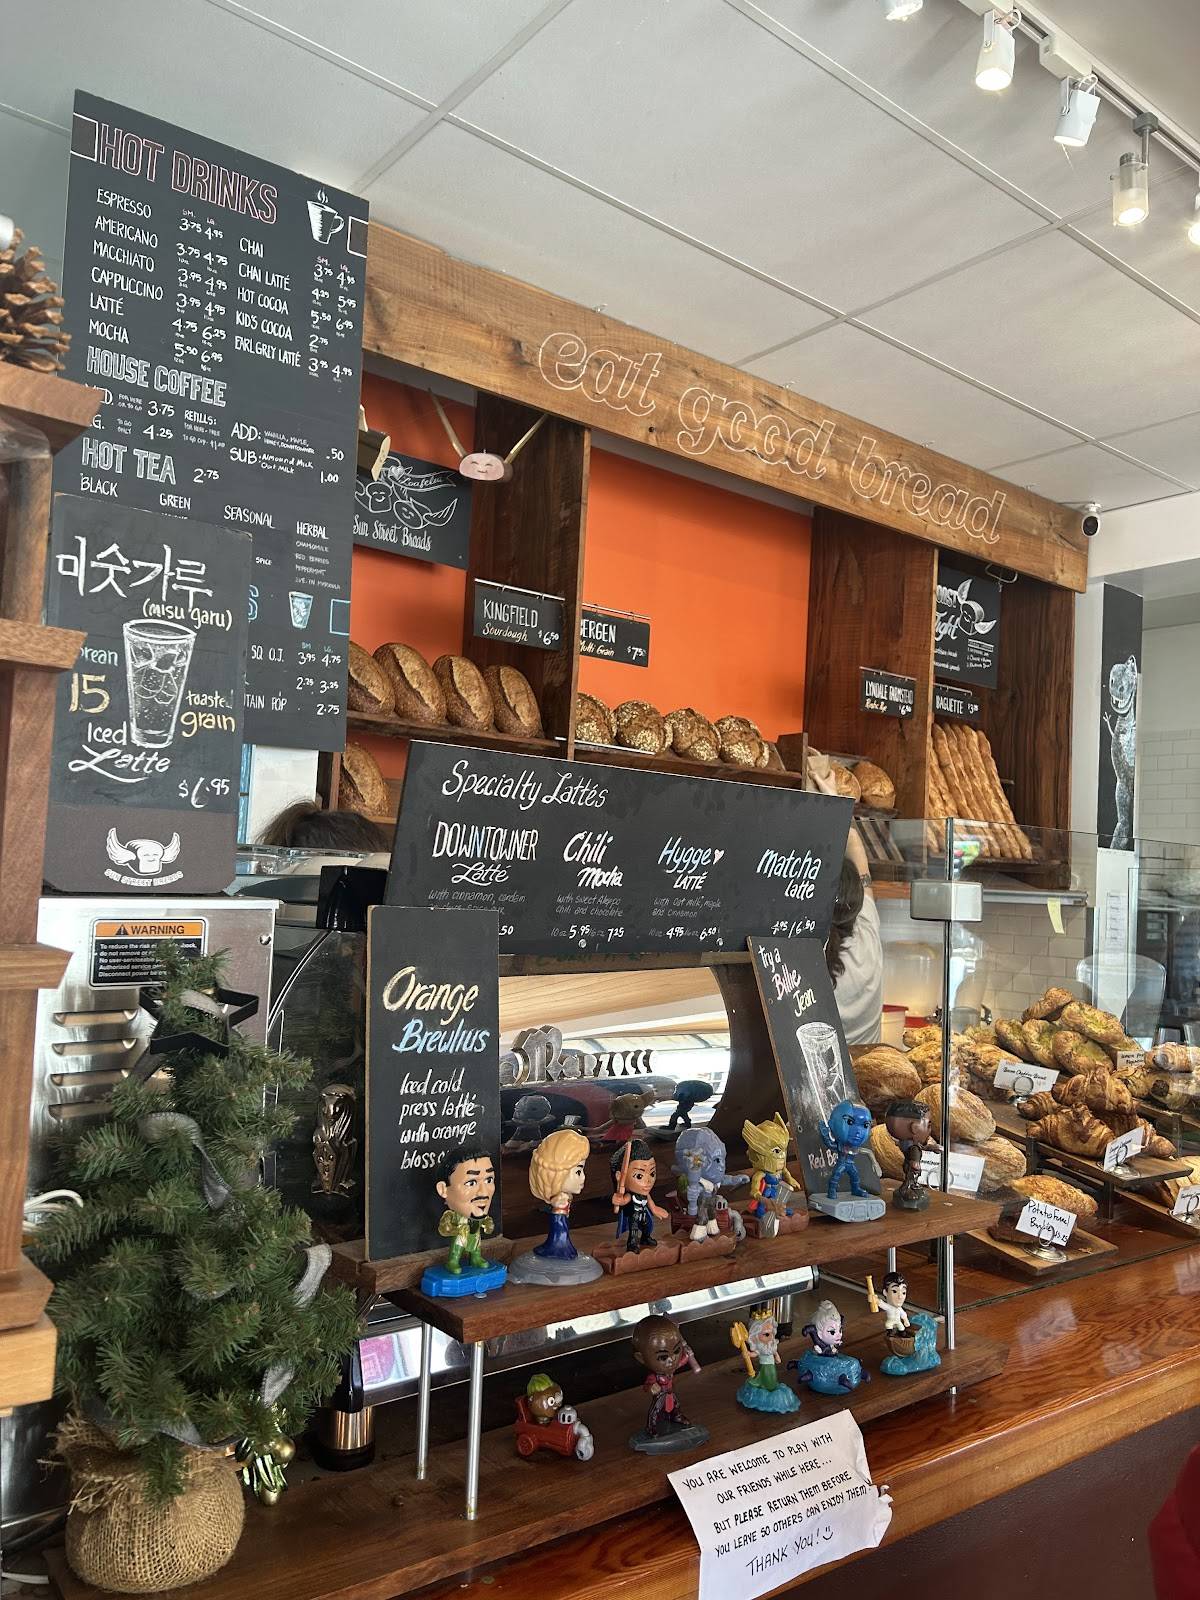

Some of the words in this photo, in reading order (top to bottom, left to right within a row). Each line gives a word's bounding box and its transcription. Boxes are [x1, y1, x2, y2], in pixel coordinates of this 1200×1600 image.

[100, 123, 164, 181] HOT
[172, 150, 277, 224] DRINKS
[97, 189, 152, 218] ESPRESSO
[95, 215, 158, 248] AMERICANO
[179, 218, 202, 233] 3.75
[204, 227, 223, 240] 4.95
[93, 240, 154, 272] MACCHIATO
[176, 243, 200, 258] 3.75
[203, 252, 228, 266] 4.75
[239, 237, 263, 258] CHAI
[91, 266, 163, 300] CAPPUCCINO
[177, 268, 201, 283] 3.95
[205, 277, 227, 291] 4.95
[239, 263, 261, 281] CHAI
[90, 293, 124, 316] LATTÉ
[176, 293, 201, 308] 3.95
[205, 302, 225, 317] 4.95
[237, 287, 255, 304] HOT
[257, 294, 288, 315] COCOA
[89, 319, 129, 344] MOCHA
[202, 326, 226, 340] 6.25
[236, 310, 258, 329] KID'S
[261, 319, 292, 341] COCOA
[201, 350, 223, 363] 6.95
[235, 336, 255, 354] EARL
[255, 341, 276, 360] GREY
[86, 346, 150, 388] HOUSE
[154, 365, 227, 408] COFFEE
[148, 401, 175, 417] 3.75
[142, 424, 173, 440] 4.25
[231, 422, 262, 442] ADD:
[540, 332, 662, 417] eat
[677, 387, 836, 480] good
[849, 438, 1006, 544] bread
[81, 437, 127, 474] HOT
[133, 449, 176, 485] TEA
[326, 448, 344, 461] .50
[80, 476, 119, 498] BLACK
[193, 468, 219, 483] 2.75
[320, 472, 339, 484] 1.00
[159, 493, 190, 510] GREEN
[224, 505, 276, 529] SEASONAL
[296, 521, 329, 540] HERBAL
[372, 519, 401, 544] Street
[401, 526, 432, 552] Breads
[55, 535, 213, 611] 미숫가루
[142, 598, 185, 620] (misu
[191, 607, 233, 631] garu)
[483, 599, 538, 629] KINGFIELD
[482, 623, 528, 642] Sourdough
[69, 673, 110, 713] 15
[936, 695, 964, 714] BAGUETTE
[316, 703, 340, 715] 2.75
[88, 722, 127, 745] Iced
[181, 709, 236, 738] grain
[68, 744, 169, 783] Latte
[441, 759, 542, 810] Specialty
[432, 821, 538, 861] DOWNTOWNER
[563, 831, 614, 865] Chili
[658, 836, 711, 872] Hygge
[756, 848, 821, 880] Matcha
[577, 865, 623, 888] Mocha
[131, 925, 185, 936] WARNING
[568, 924, 591, 939] 5.95
[758, 945, 775, 972] try
[774, 948, 781, 963] a
[772, 963, 801, 1001] Billie
[383, 966, 479, 1026] Orange
[793, 989, 816, 1017] Jean
[400, 1068, 432, 1095] Iced
[430, 1067, 462, 1095] cold
[399, 1101, 437, 1125] press
[399, 1122, 430, 1144] with
[432, 1121, 477, 1145] orange
[682, 1477, 704, 1491] YOU
[706, 1469, 726, 1483] ARE
[730, 1454, 770, 1477] WELCOME
[772, 1449, 785, 1460] TO
[787, 1441, 809, 1456] PLAY
[811, 1433, 833, 1448] WITH
[717, 1489, 735, 1504] OUR
[738, 1477, 771, 1495] FRIENDS
[774, 1470, 798, 1484] WHILE
[713, 1519, 731, 1534] BUT
[734, 1504, 764, 1526] PLEASE
[767, 1493, 799, 1511] RETURN
[799, 1483, 821, 1498] THEM
[821, 1470, 852, 1491] BEFORE
[715, 1544, 730, 1558] YOU
[733, 1532, 757, 1550] LEAVE
[760, 1525, 771, 1537] SO
[773, 1513, 803, 1532] OTHERS
[806, 1503, 821, 1517] CAN
[821, 1493, 845, 1510] ENJOY
[746, 1544, 788, 1576] THANK
[794, 1528, 820, 1554] YOU!
